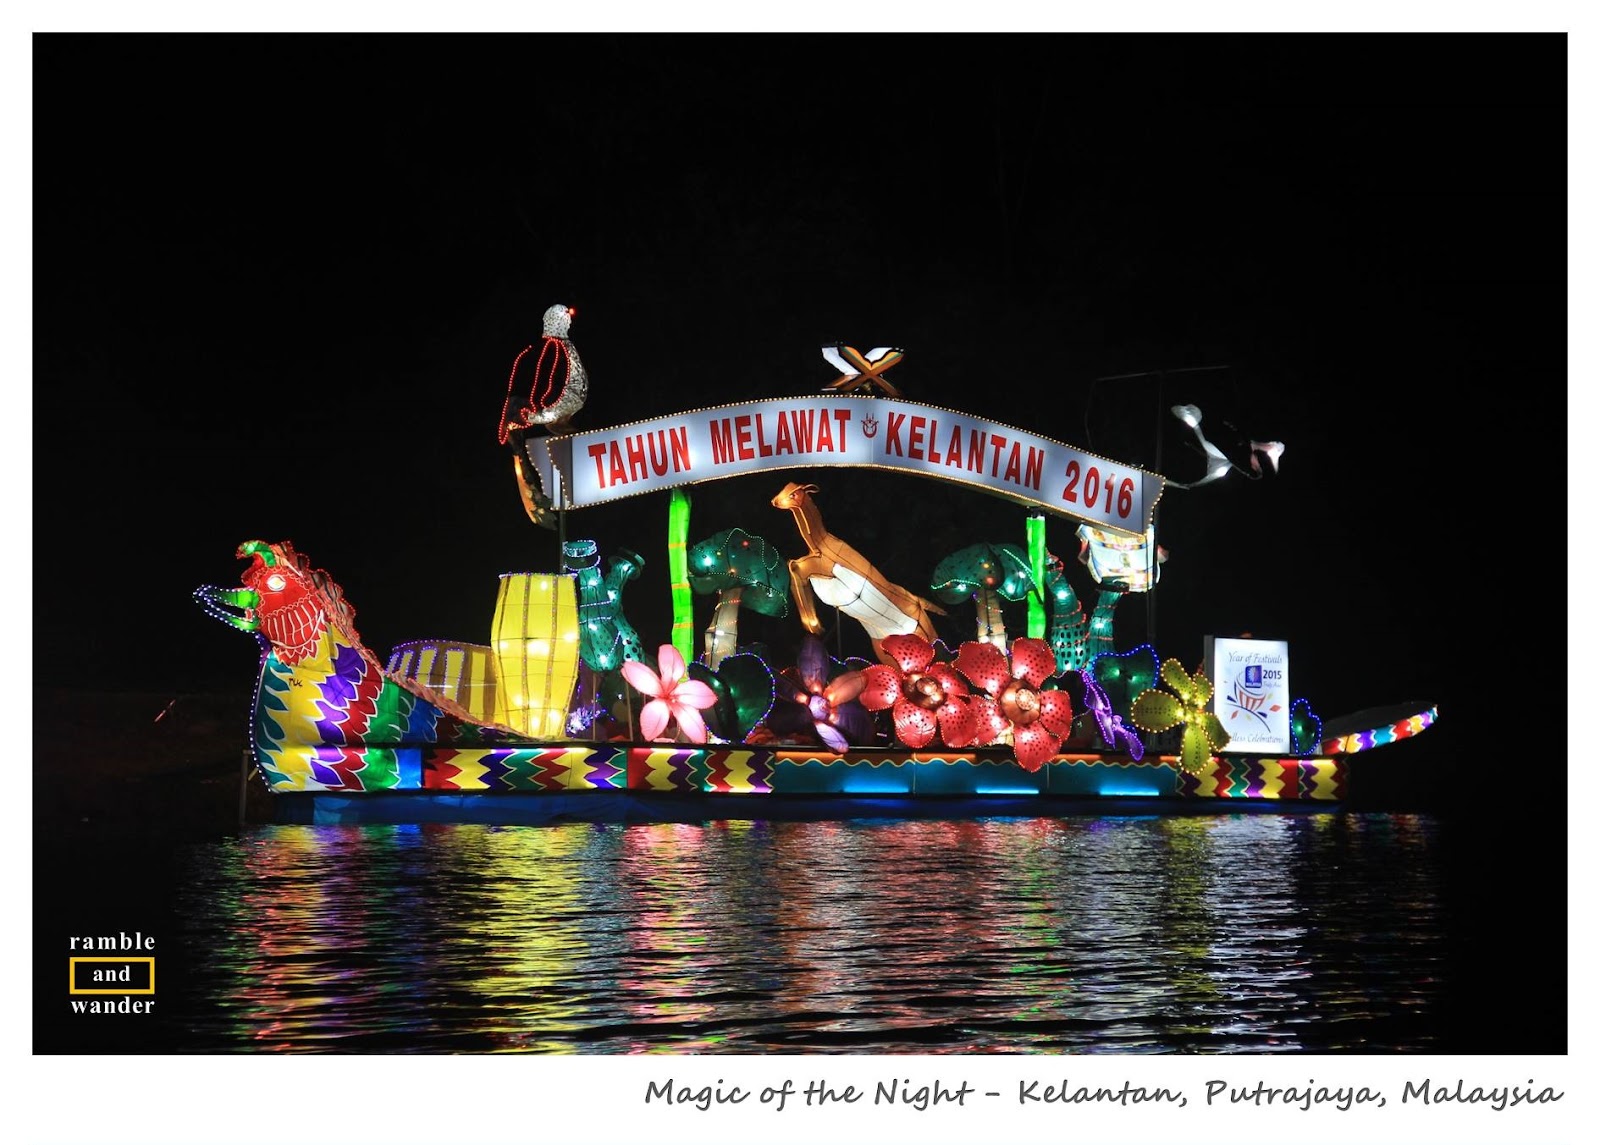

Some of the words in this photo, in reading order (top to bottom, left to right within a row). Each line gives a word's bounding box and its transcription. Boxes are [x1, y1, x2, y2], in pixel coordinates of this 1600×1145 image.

[588, 426, 691, 489] TAHUN
[709, 409, 851, 465] MELAWAT
[885, 412, 1045, 491] KELANTAN
[1062, 460, 1135, 519] 2016
[1229, 651, 1244, 662] Year
[1245, 652, 1253, 664] of
[1254, 653, 1283, 665] Festivals
[1263, 670, 1282, 680] 2015
[1232, 732, 1246, 742] dless
